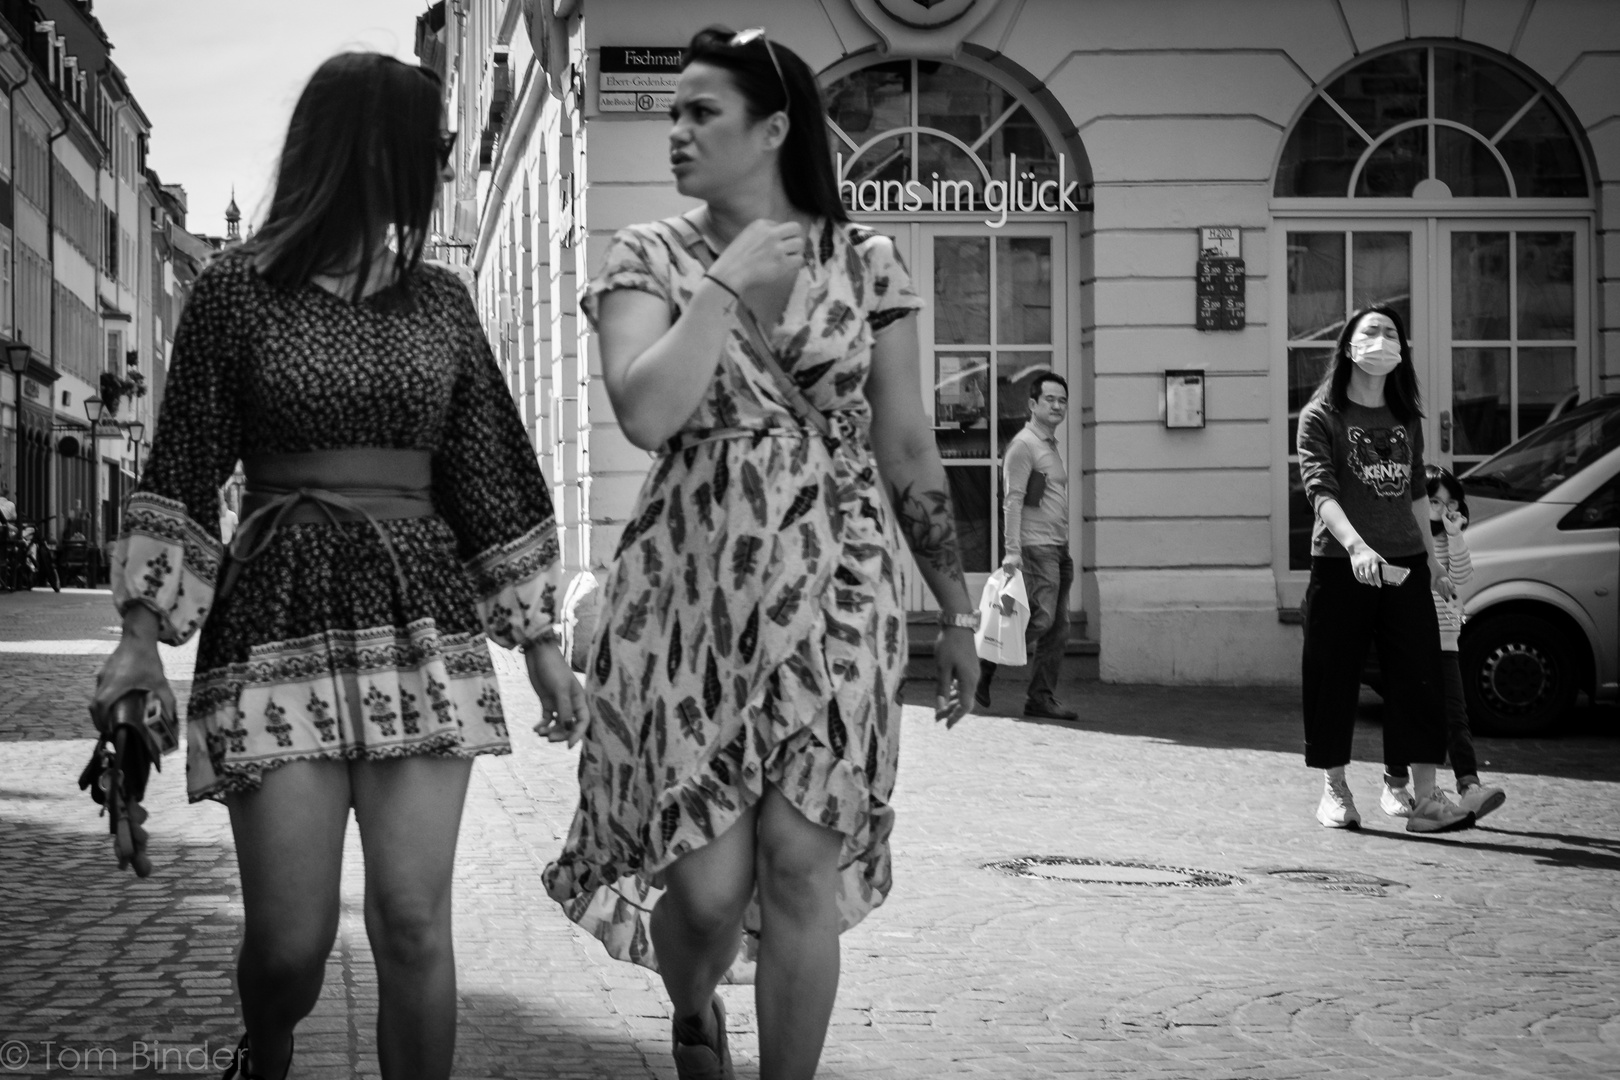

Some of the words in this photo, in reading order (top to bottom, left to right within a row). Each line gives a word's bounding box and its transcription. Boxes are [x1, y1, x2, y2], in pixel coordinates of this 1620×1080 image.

[836, 152, 923, 212] hans
[932, 171, 974, 212] im
[984, 152, 1079, 228] glück
